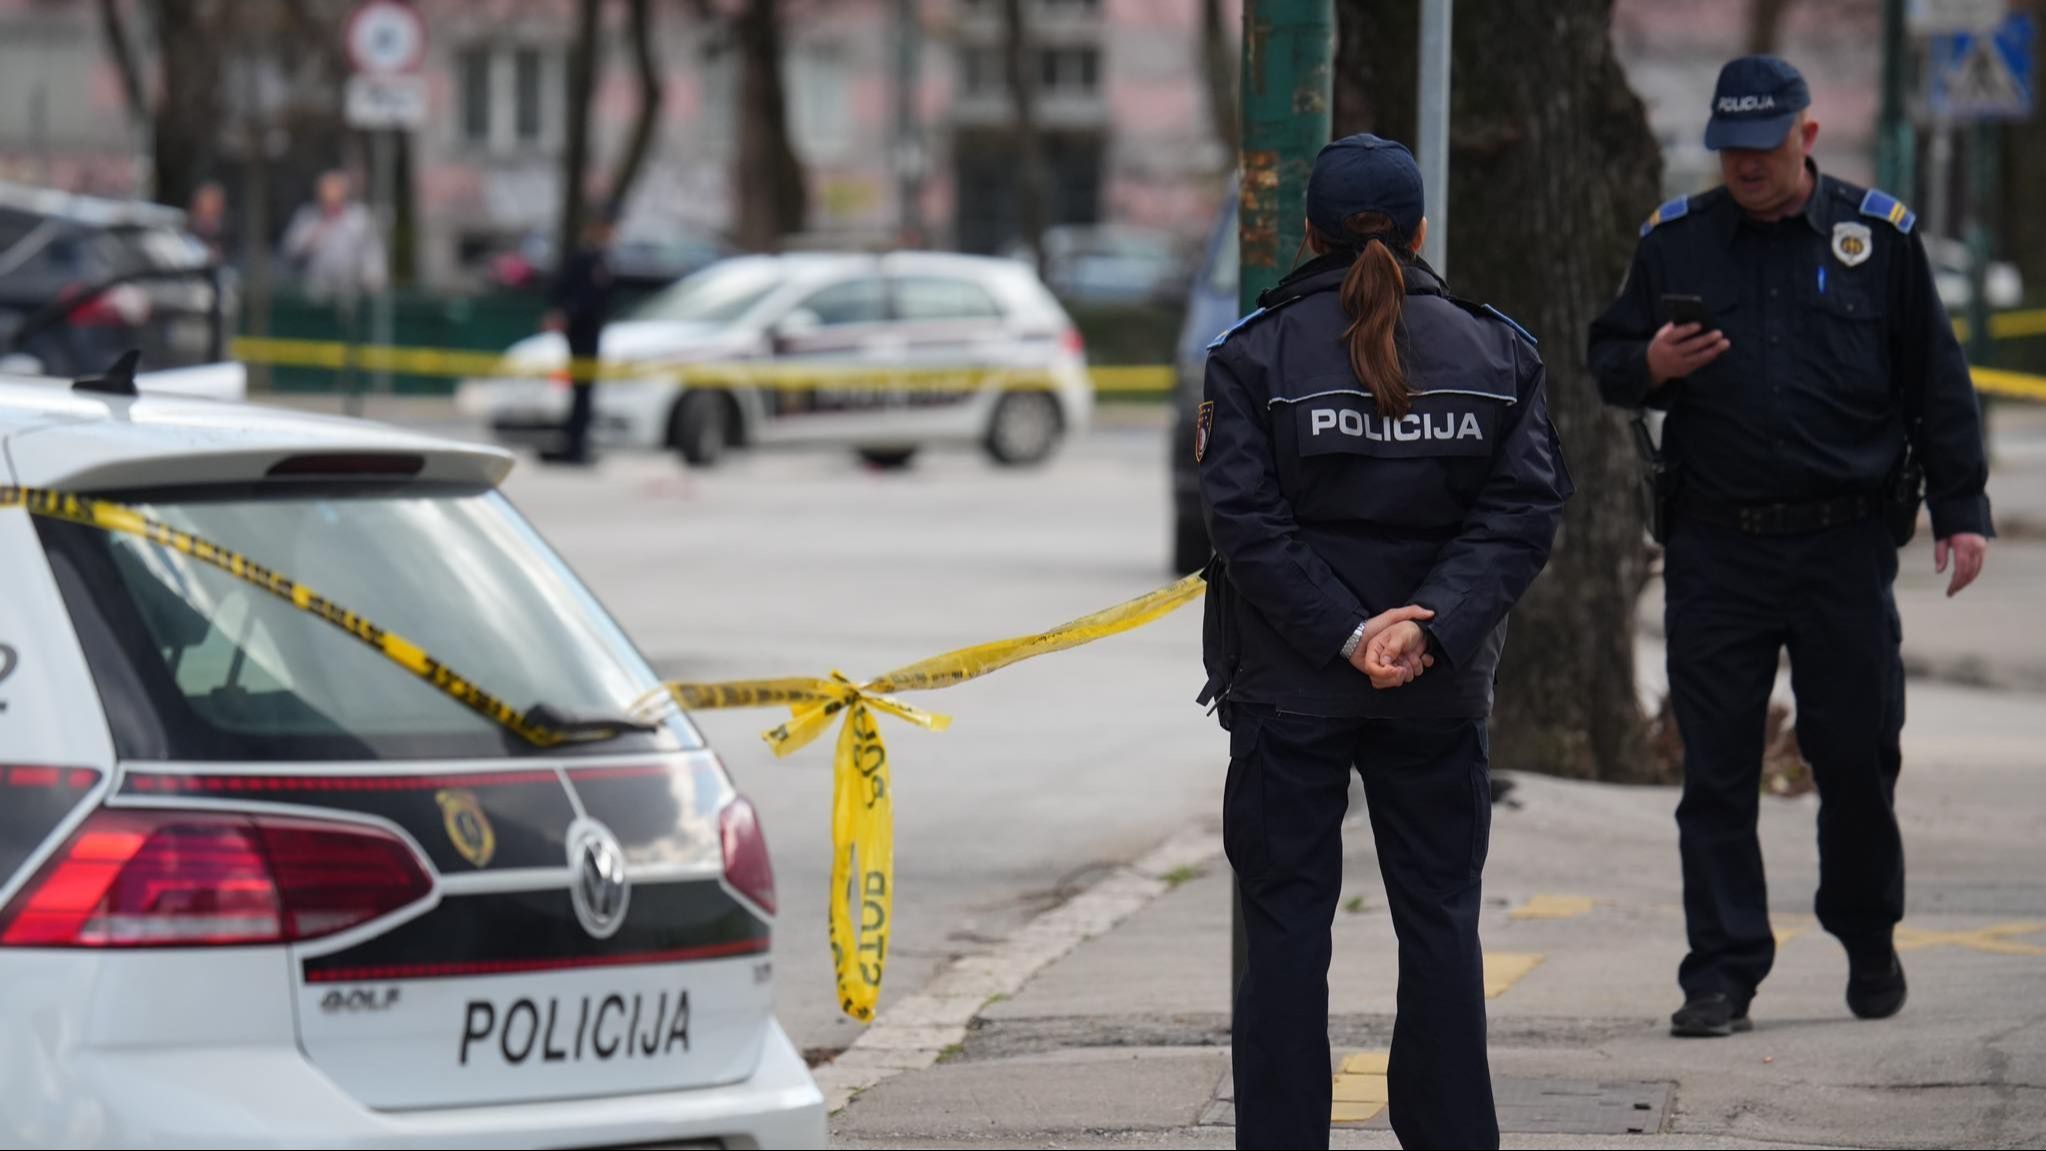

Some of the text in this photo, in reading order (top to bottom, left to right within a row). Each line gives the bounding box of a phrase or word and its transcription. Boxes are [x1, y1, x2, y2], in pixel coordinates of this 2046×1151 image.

[1718, 95, 1775, 112] POLICIJA
[1311, 408, 1484, 442] POLICIJA
[319, 988, 401, 1013] GOLF
[458, 989, 691, 1066] POLICIJA
